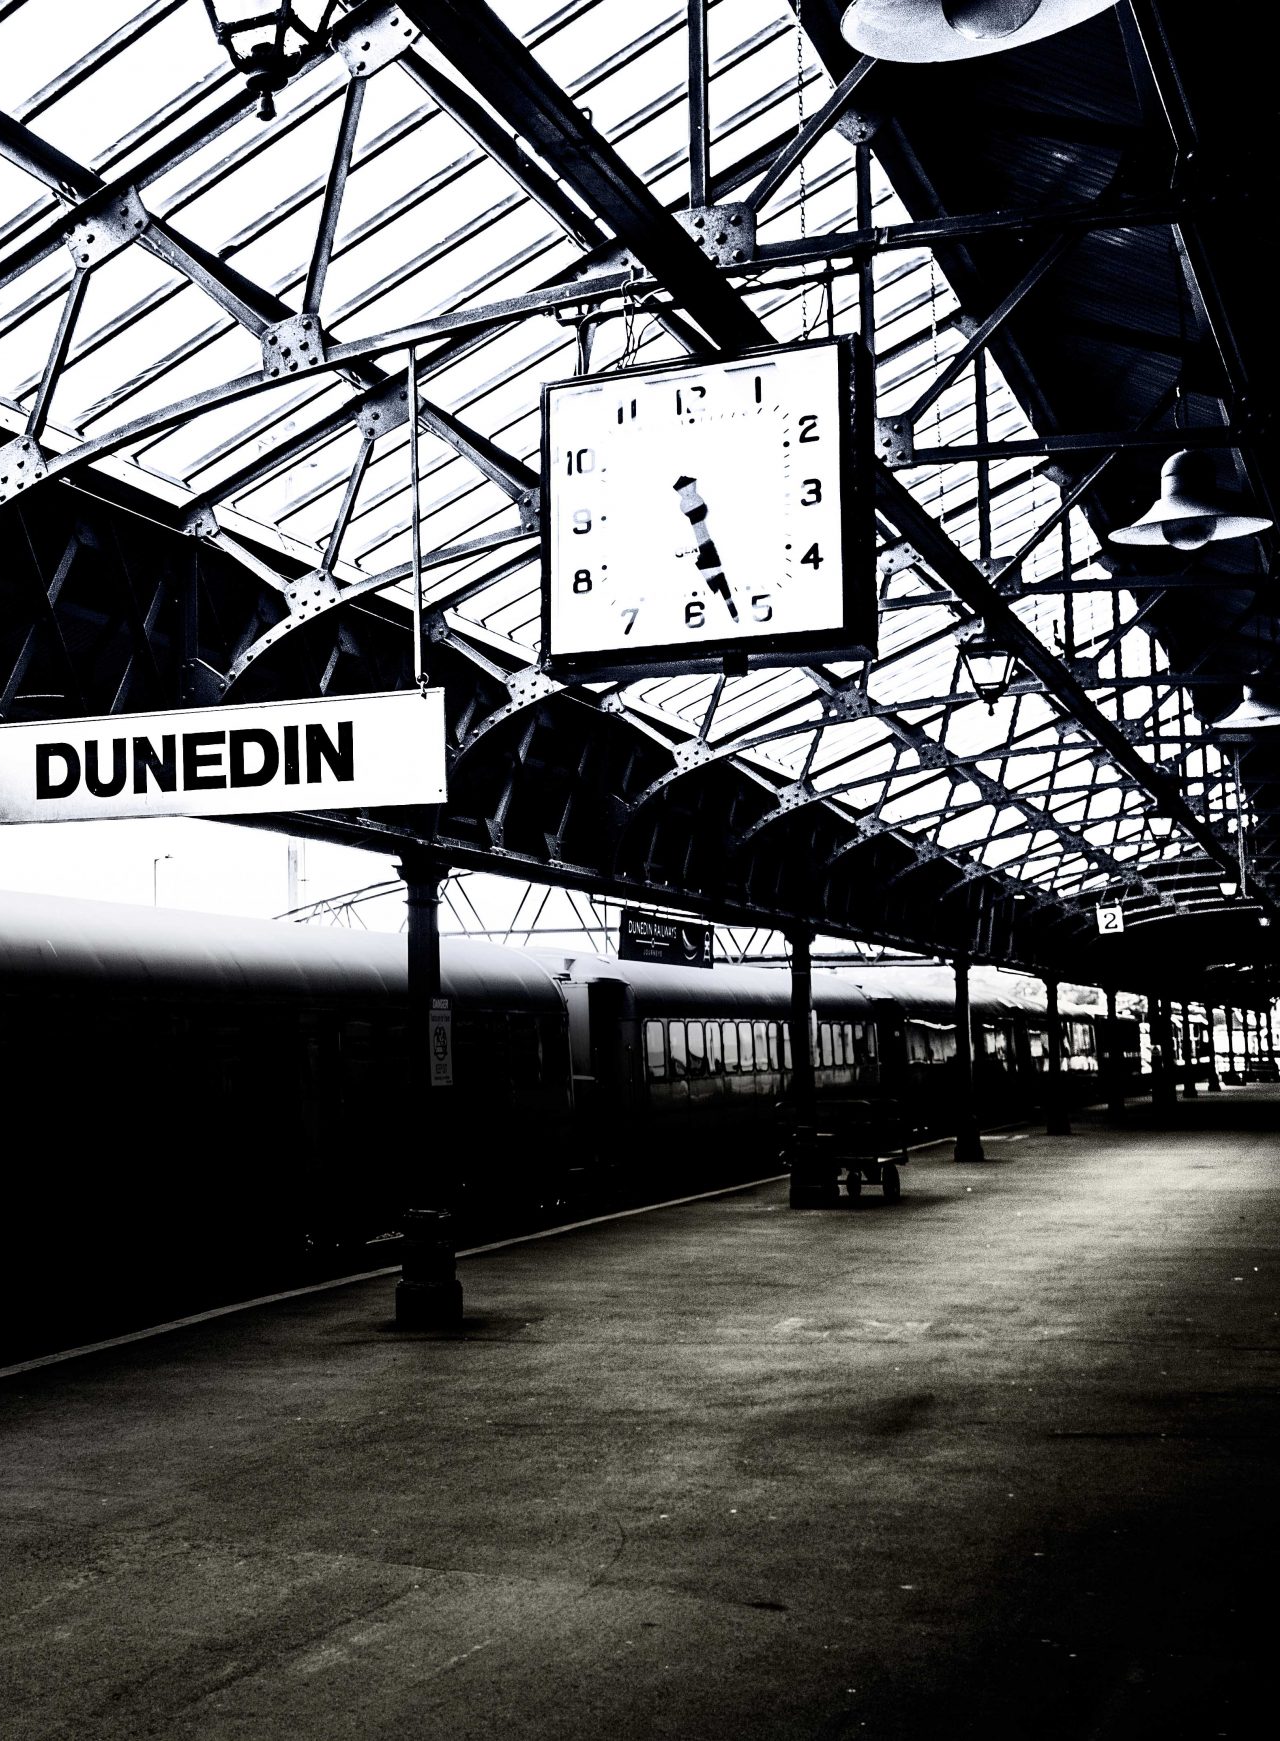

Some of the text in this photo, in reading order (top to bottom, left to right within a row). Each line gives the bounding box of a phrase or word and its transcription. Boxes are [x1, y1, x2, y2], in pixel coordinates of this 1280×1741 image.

[676, 385, 706, 415] 12
[754, 376, 762, 403] 1
[617, 398, 637, 425] 11
[798, 415, 820, 443] 2
[566, 448, 595, 476] 10
[800, 478, 822, 506] 3
[572, 508, 592, 534] 9
[800, 542, 823, 570] 4
[572, 568, 593, 594] 8
[620, 607, 639, 635] 7
[684, 600, 705, 628] 6
[751, 594, 772, 622] 5
[36, 720, 355, 800] DUNEDIN
[628, 920, 677, 939] DUNEDIN RAILWAYS
[1104, 912, 1118, 929] 2
